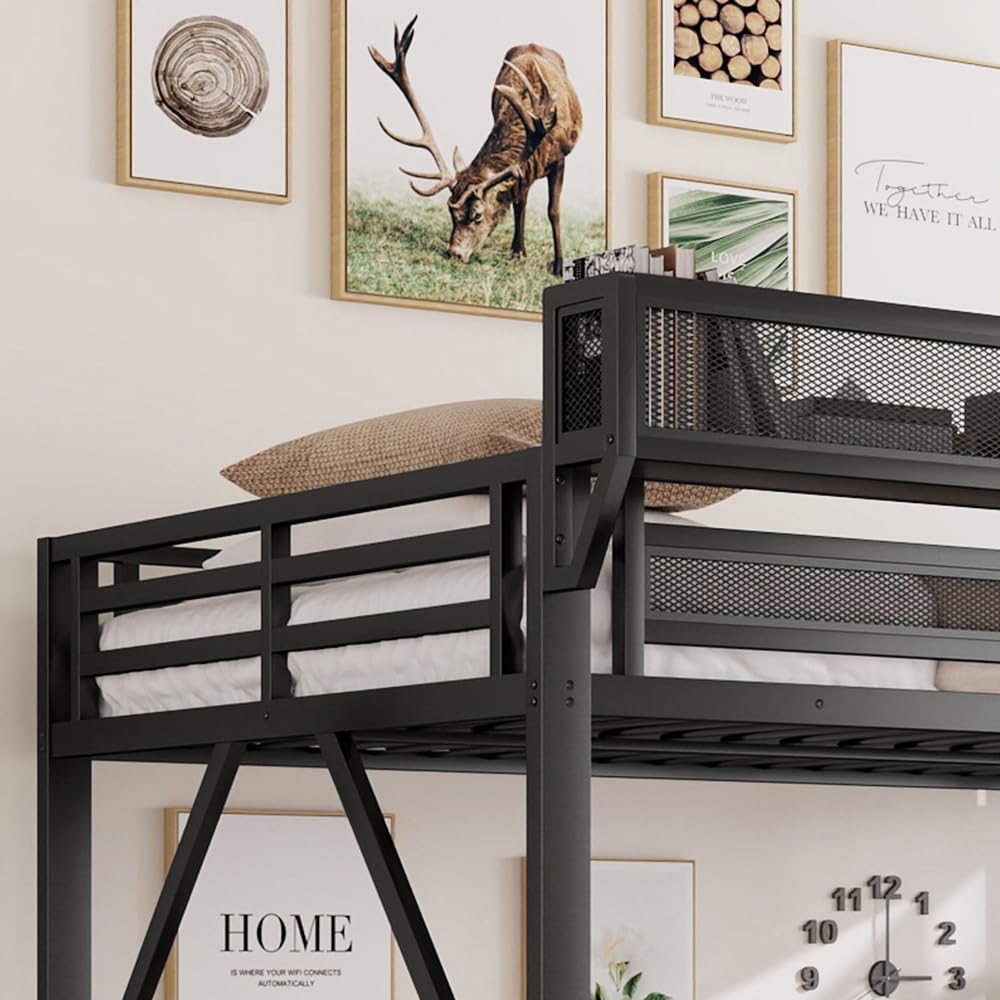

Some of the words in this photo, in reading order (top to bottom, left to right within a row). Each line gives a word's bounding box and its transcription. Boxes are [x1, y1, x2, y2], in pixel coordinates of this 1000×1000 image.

[855, 159, 990, 208] Together
[864, 200, 889, 217] WE
[896, 205, 941, 224] HAVE
[947, 211, 964, 227] IT
[968, 216, 997, 232] ALL
[831, 887, 862, 912] 11
[867, 875, 902, 900] 12
[914, 891, 930, 915] 1
[219, 912, 353, 953] HOME
[802, 919, 838, 944] 10
[937, 921, 957, 945] 2
[230, 968, 238, 977] IS
[239, 968, 265, 977] WHERE
[265, 968, 286, 977] YOUR
[287, 968, 302, 977] WIFI
[303, 968, 343, 977] CONNECTS
[257, 979, 316, 988] AUTOMATICALLY
[800, 966, 819, 991] 9
[948, 966, 966, 991] 3
